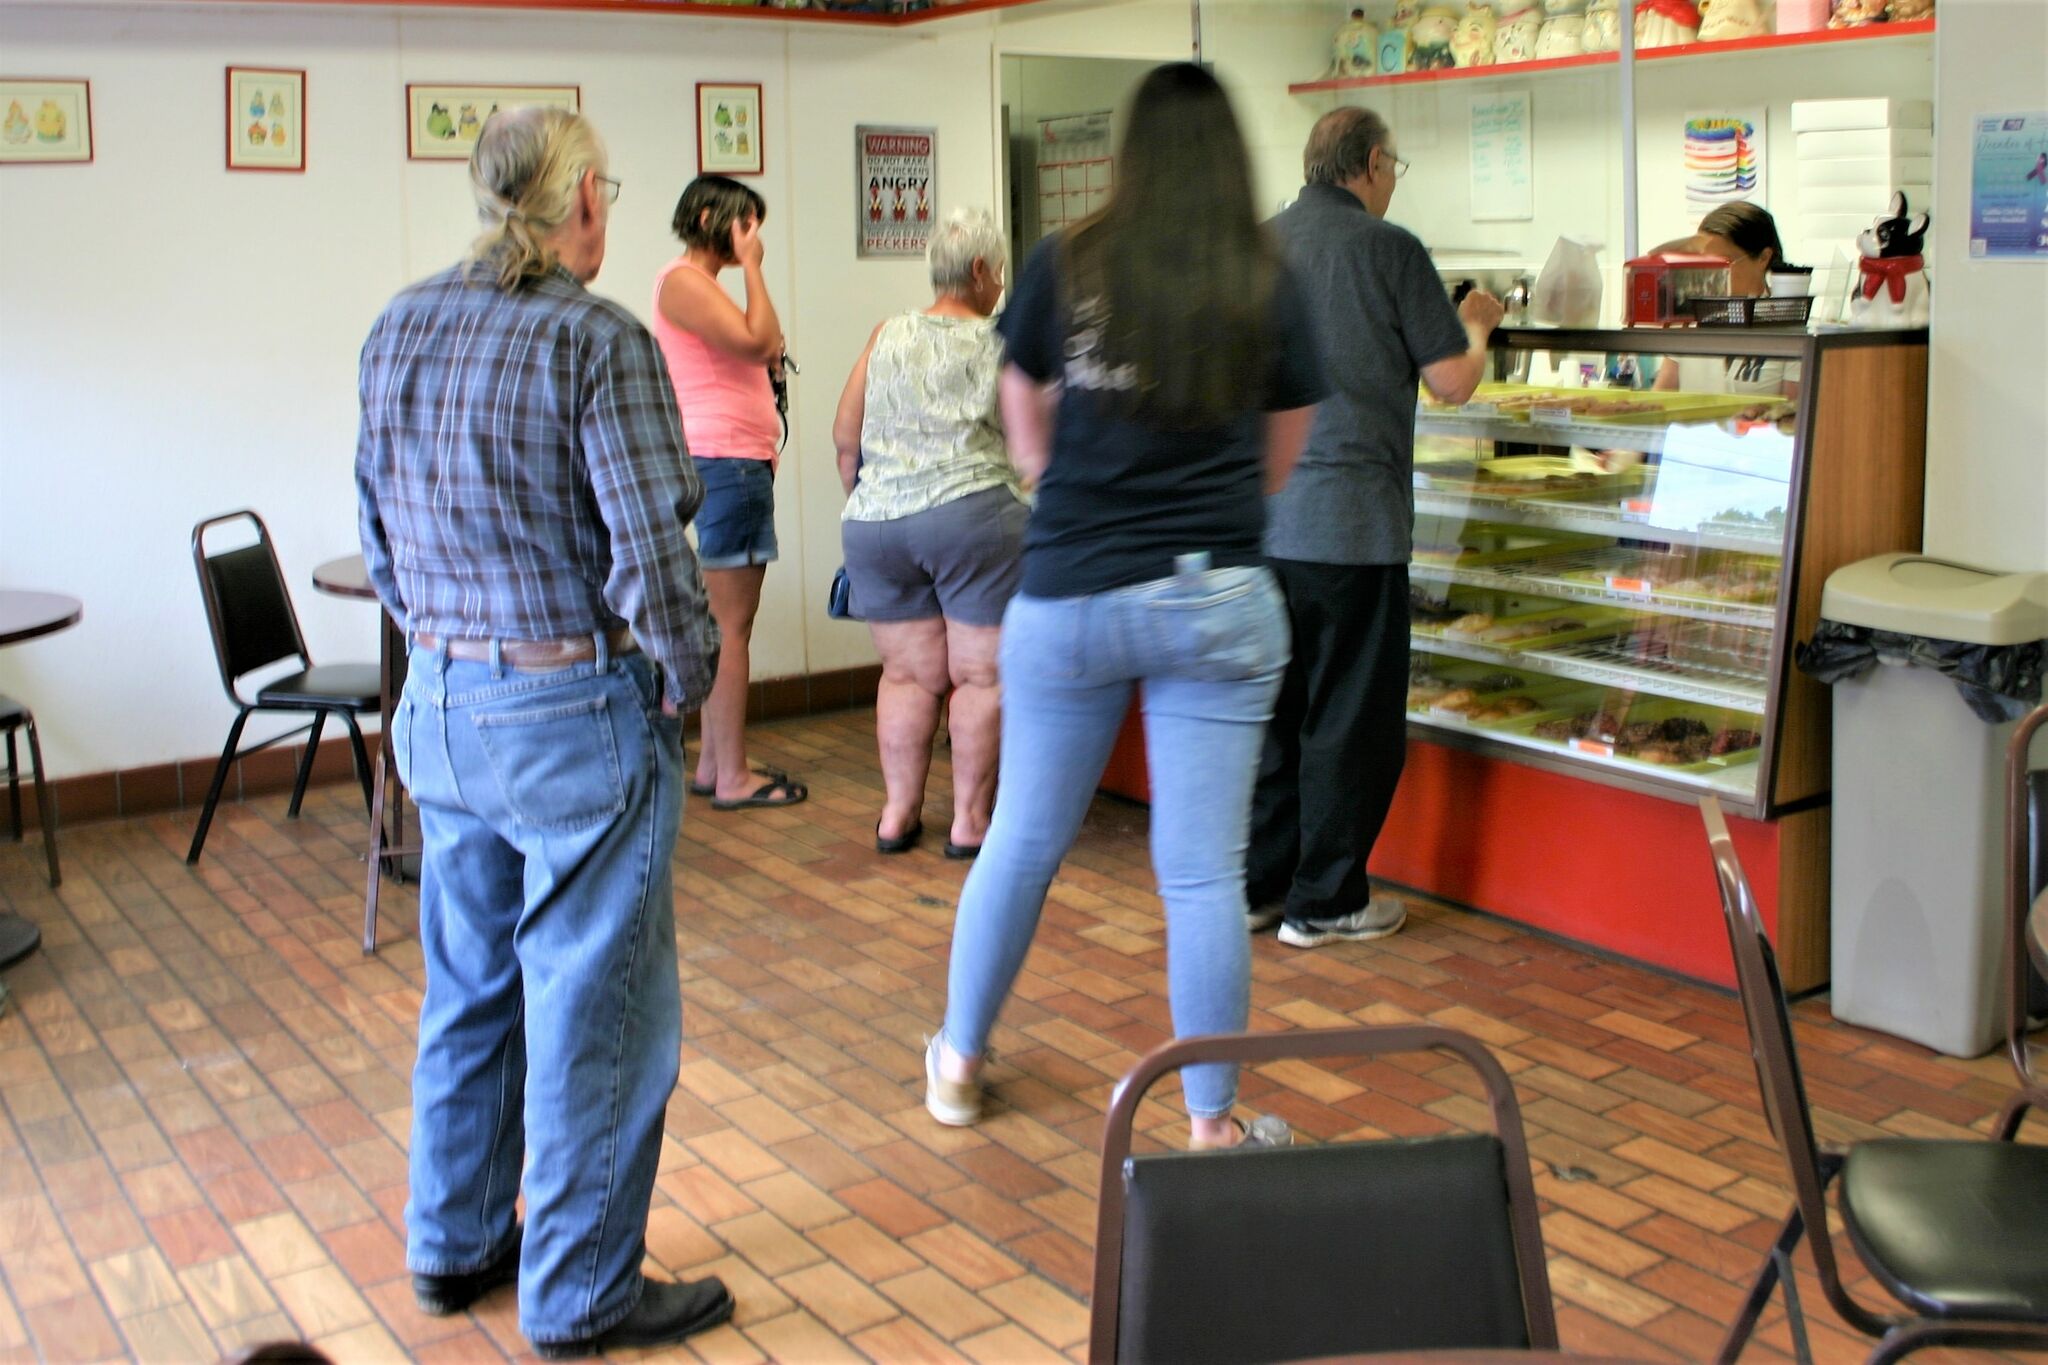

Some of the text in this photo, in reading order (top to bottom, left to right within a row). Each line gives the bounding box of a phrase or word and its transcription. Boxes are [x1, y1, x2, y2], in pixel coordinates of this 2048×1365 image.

[1381, 44, 1398, 72] C
[867, 137, 929, 154] WARNING
[867, 157, 928, 165] DO NOT MAKE
[868, 165, 929, 175] THE CHICKENS
[869, 176, 929, 191] ANGRY
[867, 238, 928, 250] PECKERS
